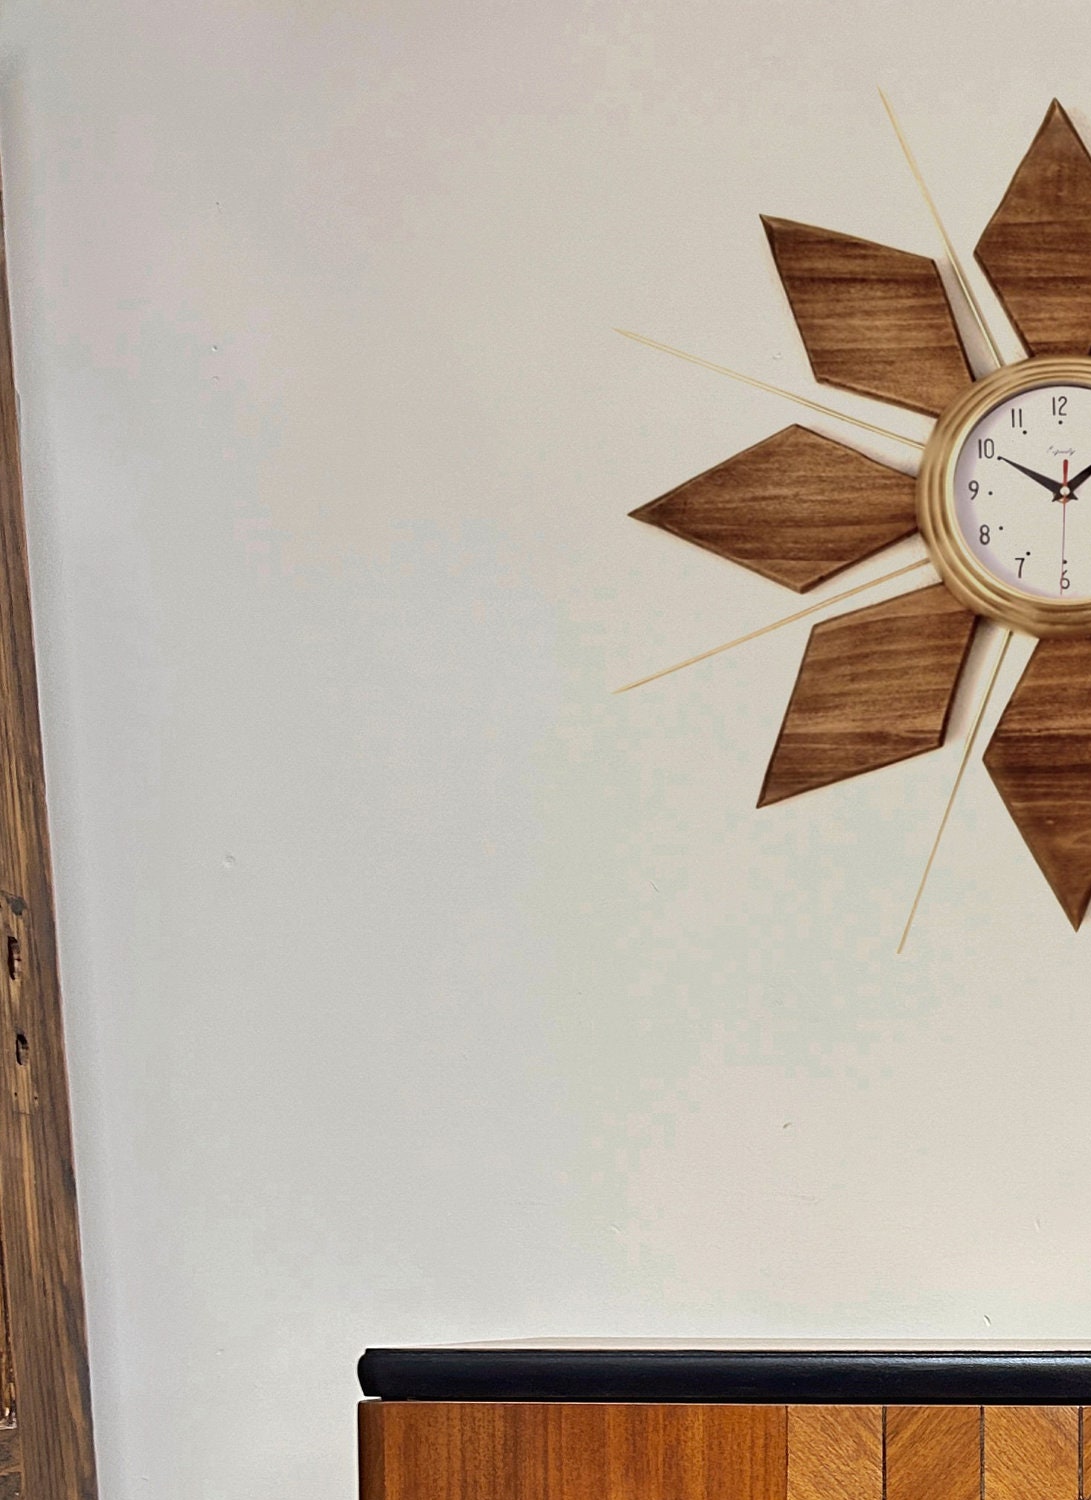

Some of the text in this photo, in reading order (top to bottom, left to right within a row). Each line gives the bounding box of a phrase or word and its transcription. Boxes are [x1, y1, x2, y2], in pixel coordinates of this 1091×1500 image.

[1052, 396, 1068, 417] 12
[1011, 408, 1023, 428] 11
[978, 438, 995, 459] 10
[968, 480, 980, 500] 9
[979, 524, 991, 545] 8
[1014, 557, 1026, 579] 7
[1060, 569, 1071, 590] 6
